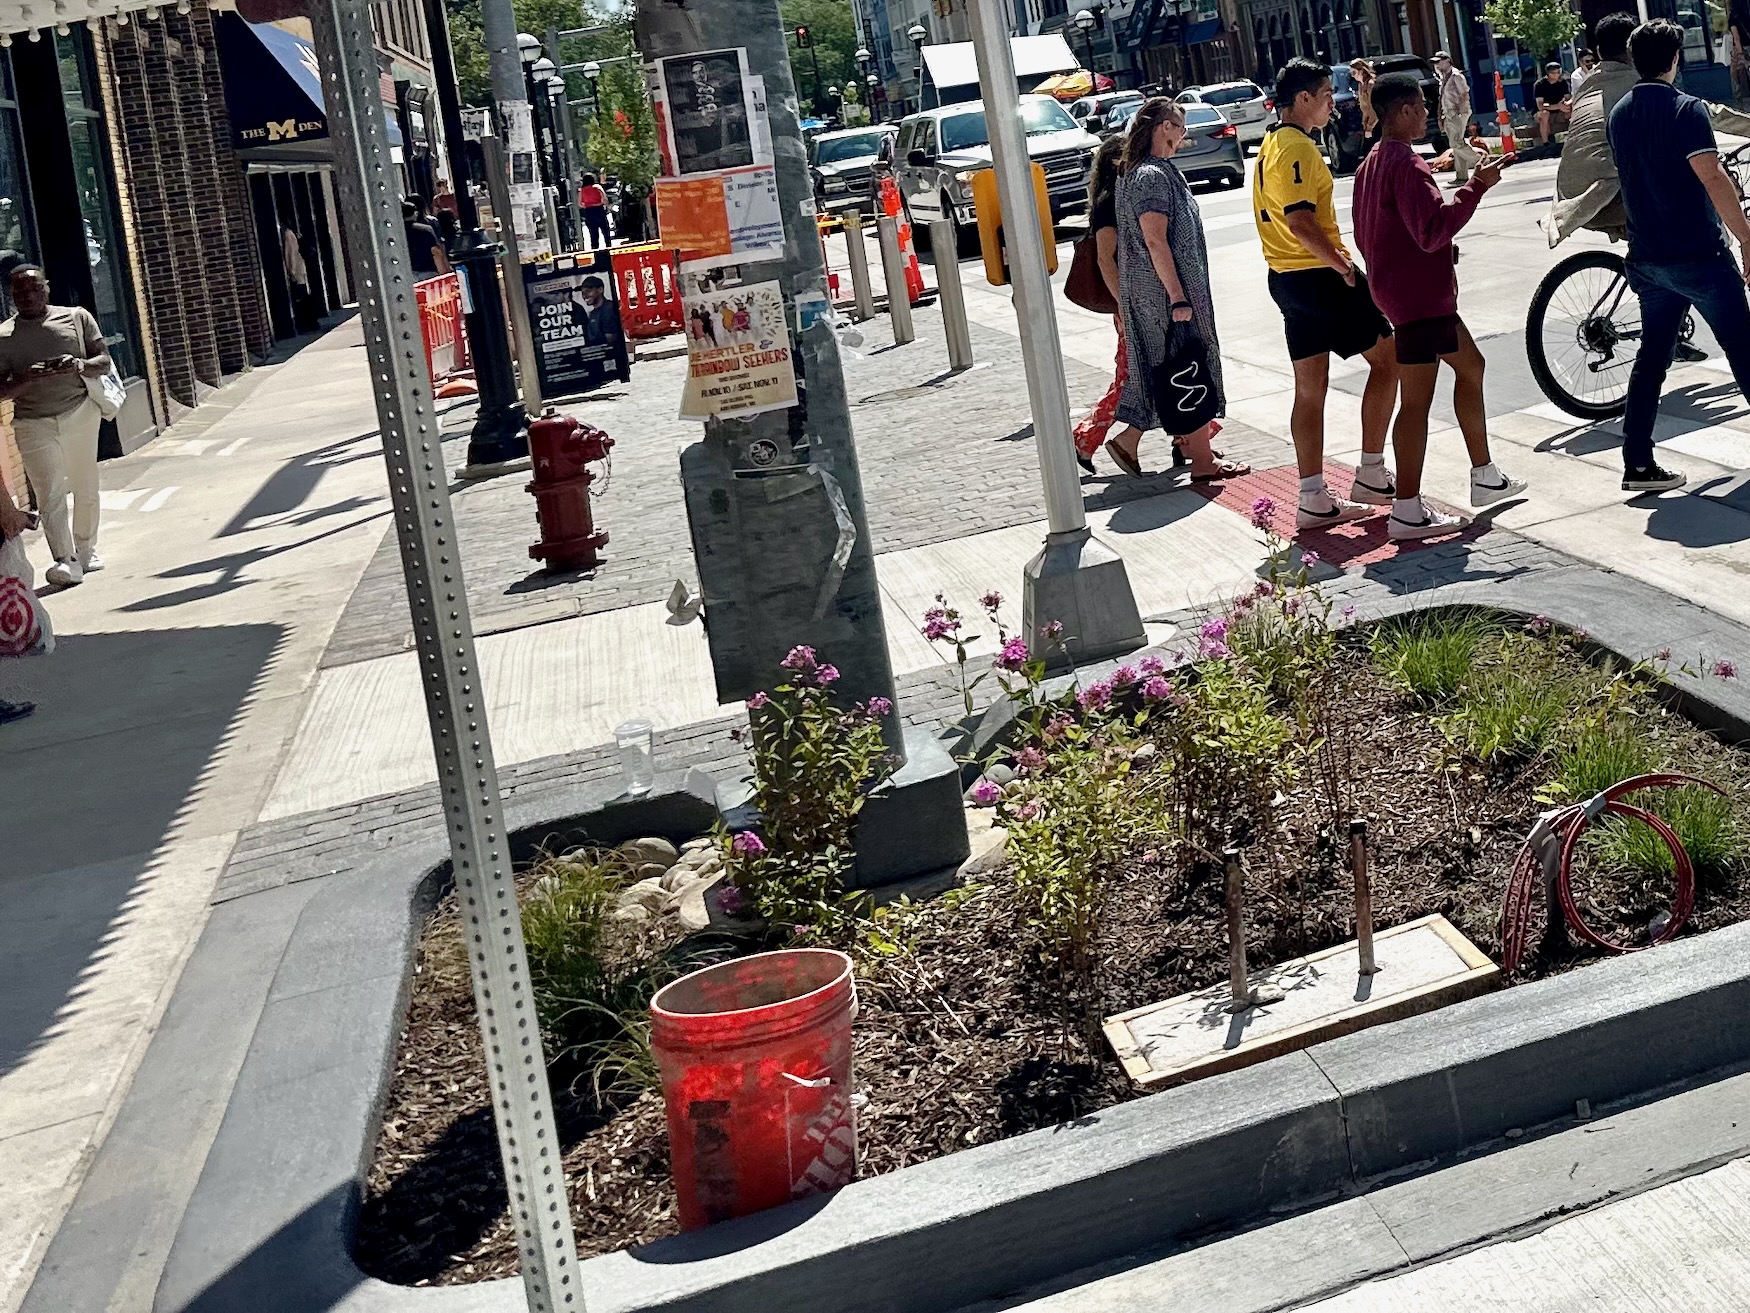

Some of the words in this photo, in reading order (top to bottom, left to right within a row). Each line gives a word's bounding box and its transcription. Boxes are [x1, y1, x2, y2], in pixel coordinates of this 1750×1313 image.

[240, 127, 267, 140] THE
[266, 118, 298, 141] M
[298, 120, 323, 132] DEN
[1292, 160, 1303, 184] 1
[538, 301, 573, 317] JOIN
[540, 314, 573, 329] OUR
[541, 324, 584, 341] TEAM
[702, 342, 756, 359] HERTLER
[742, 347, 789, 369] SEEKERS
